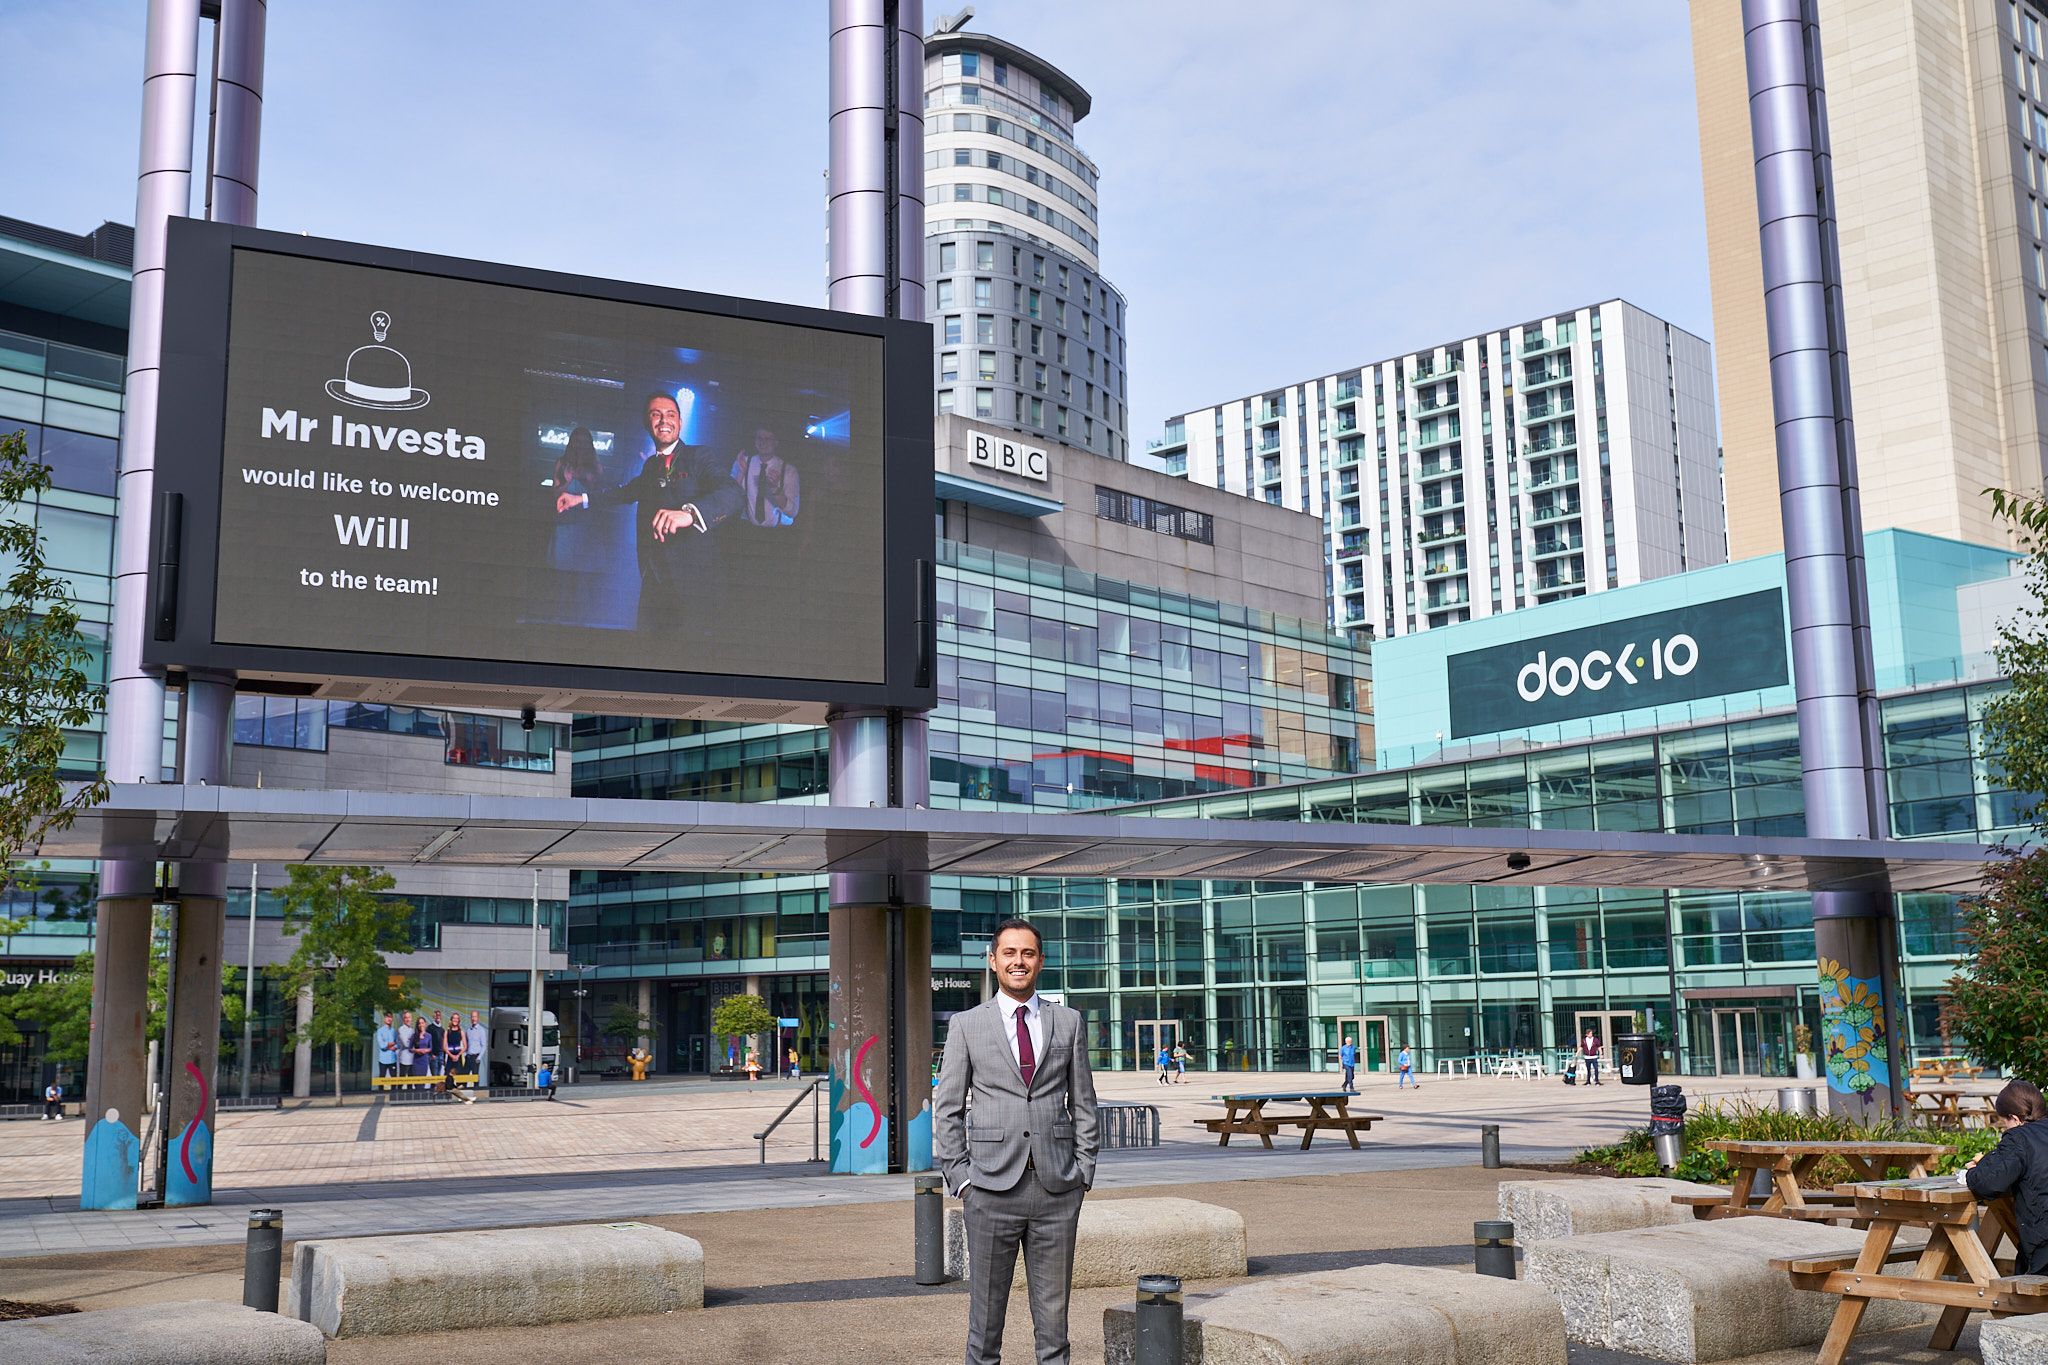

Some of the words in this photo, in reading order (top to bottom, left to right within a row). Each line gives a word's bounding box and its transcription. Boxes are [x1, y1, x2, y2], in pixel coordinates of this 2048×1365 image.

[261, 407, 319, 443] Mr
[331, 414, 486, 461] Investa
[976, 436, 1043, 475] BBC
[241, 468, 315, 490] would
[322, 471, 364, 494] like
[369, 478, 393, 497] to
[399, 482, 500, 507] welcome
[333, 513, 409, 551] Will
[299, 568, 324, 587] to
[330, 569, 368, 590] the
[374, 573, 438, 596] team!
[713, 982, 740, 994] BBC
[945, 977, 971, 989] House
